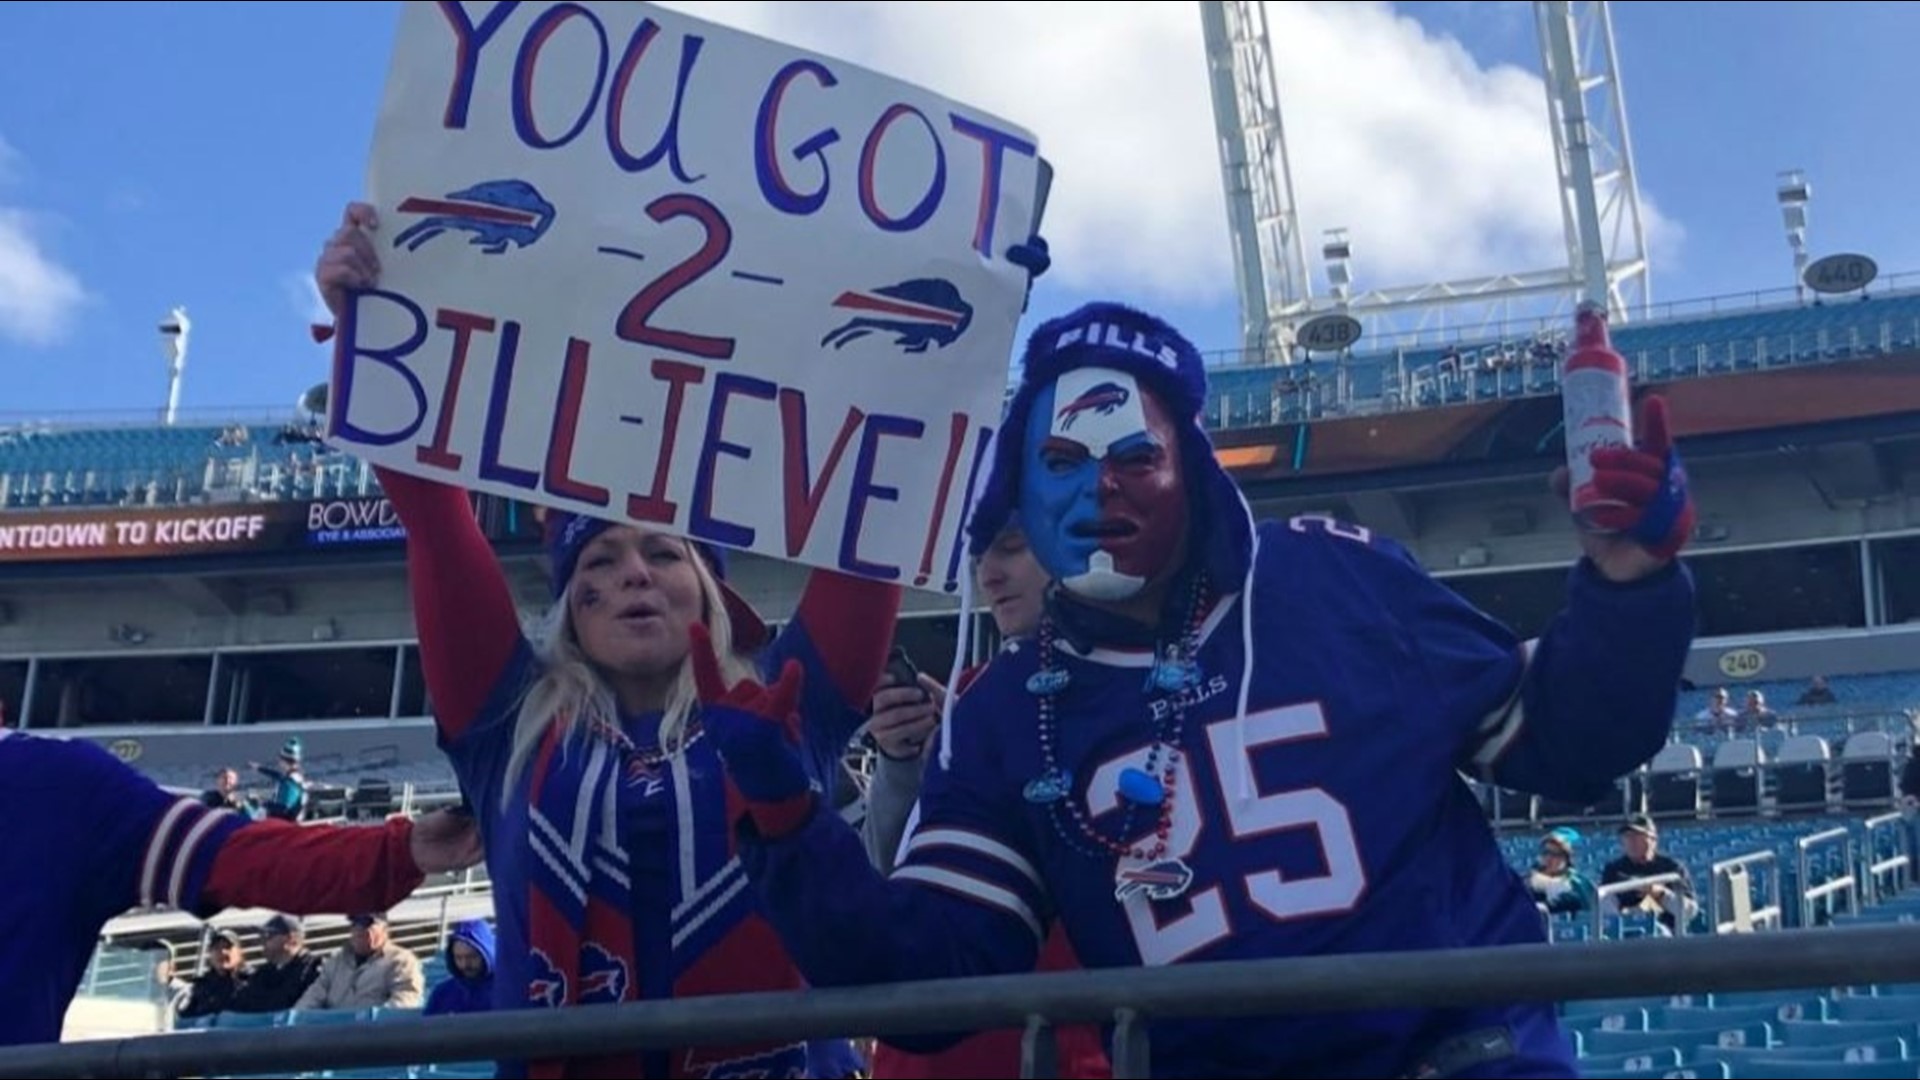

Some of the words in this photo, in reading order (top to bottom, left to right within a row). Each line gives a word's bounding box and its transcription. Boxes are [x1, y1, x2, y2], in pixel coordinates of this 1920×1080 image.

[436, 0, 706, 183] YOU
[754, 59, 1037, 259] GOT
[1817, 261, 1863, 284] 440
[1308, 321, 1350, 345] 438
[115, 520, 148, 545] TO
[155, 515, 265, 544] KICKOFF
[1725, 653, 1760, 673] 240
[1087, 701, 1367, 968] 25
